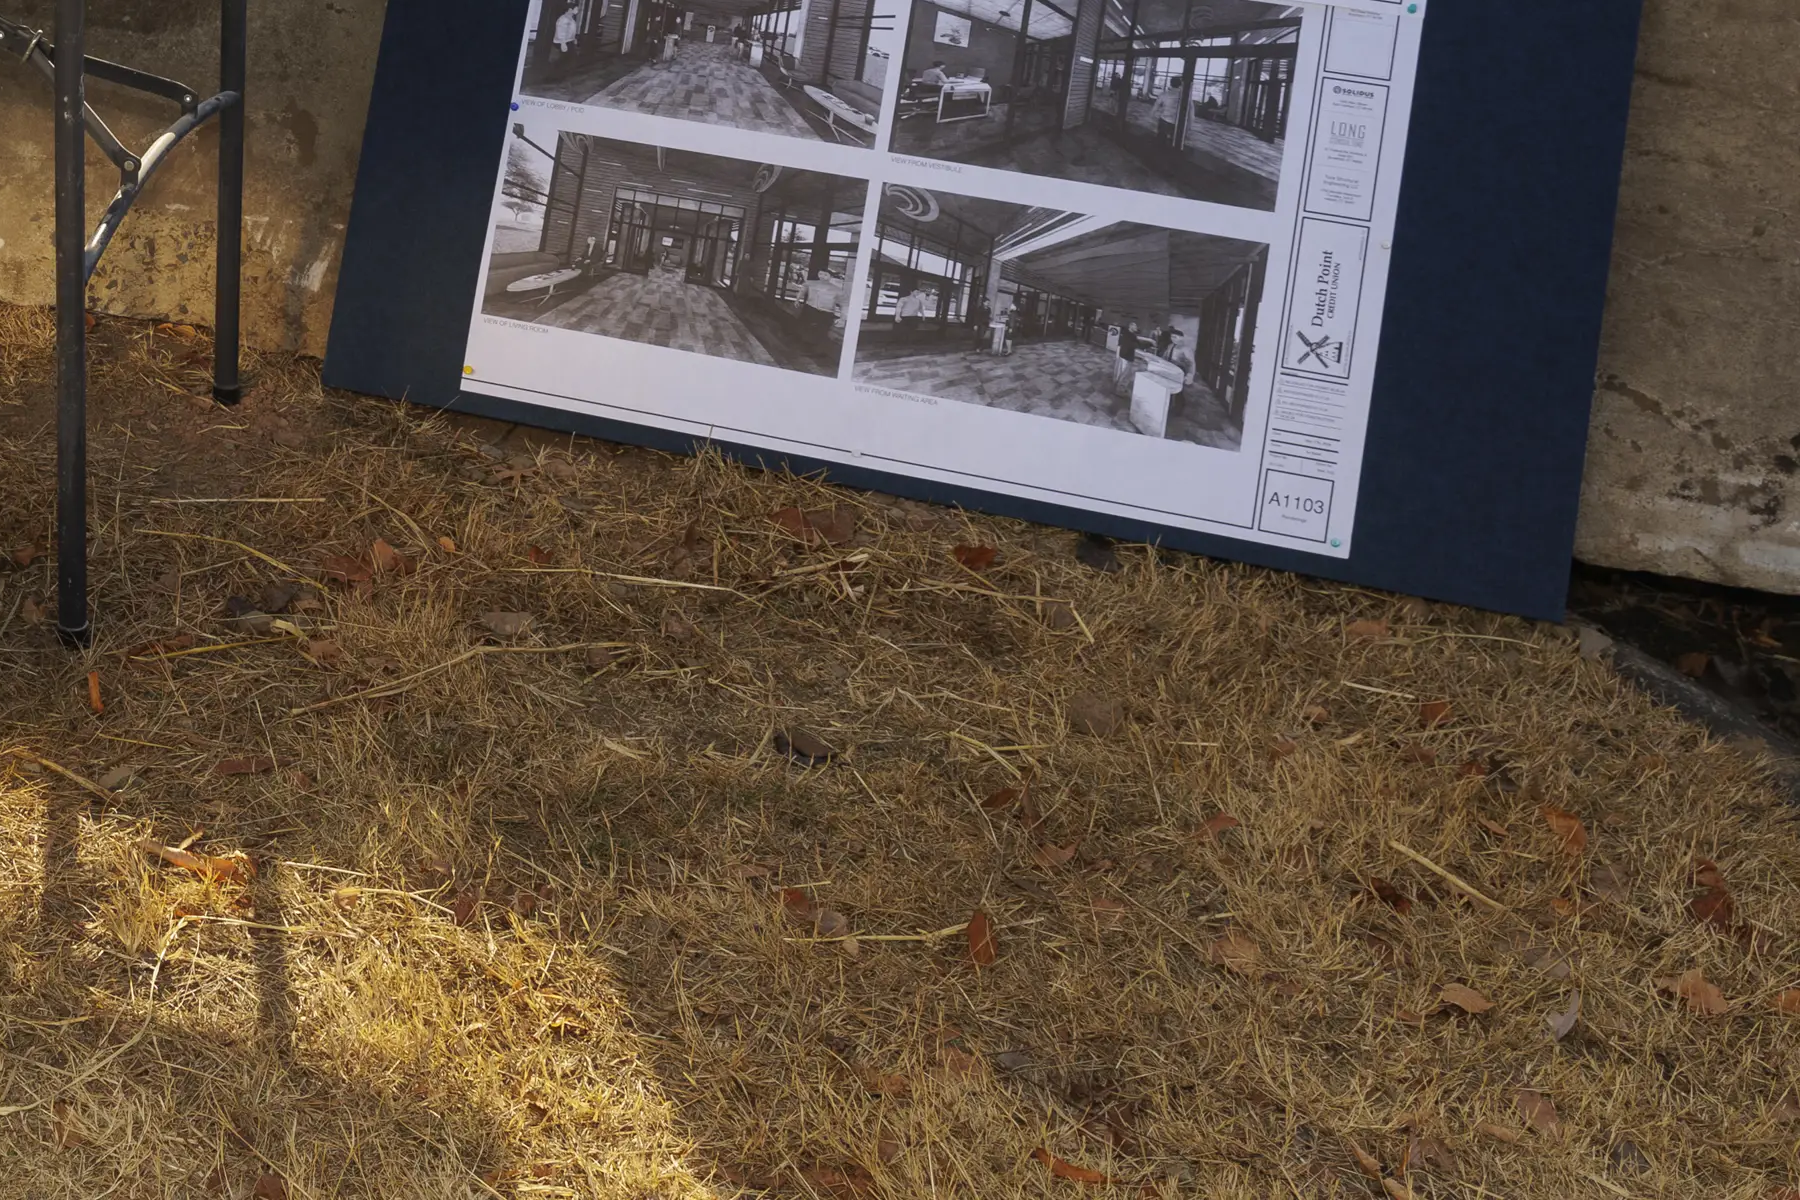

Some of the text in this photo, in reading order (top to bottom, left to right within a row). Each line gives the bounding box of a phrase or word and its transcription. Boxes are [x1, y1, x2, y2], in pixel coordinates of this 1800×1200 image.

[1342, 88, 1375, 98] SOLIDUS
[1330, 121, 1366, 139] LONG
[1311, 250, 1334, 327] Dutch Point
[1327, 262, 1341, 319] CREDIT UNION
[483, 317, 498, 325] VIEW
[1268, 492, 1325, 515] A1103
